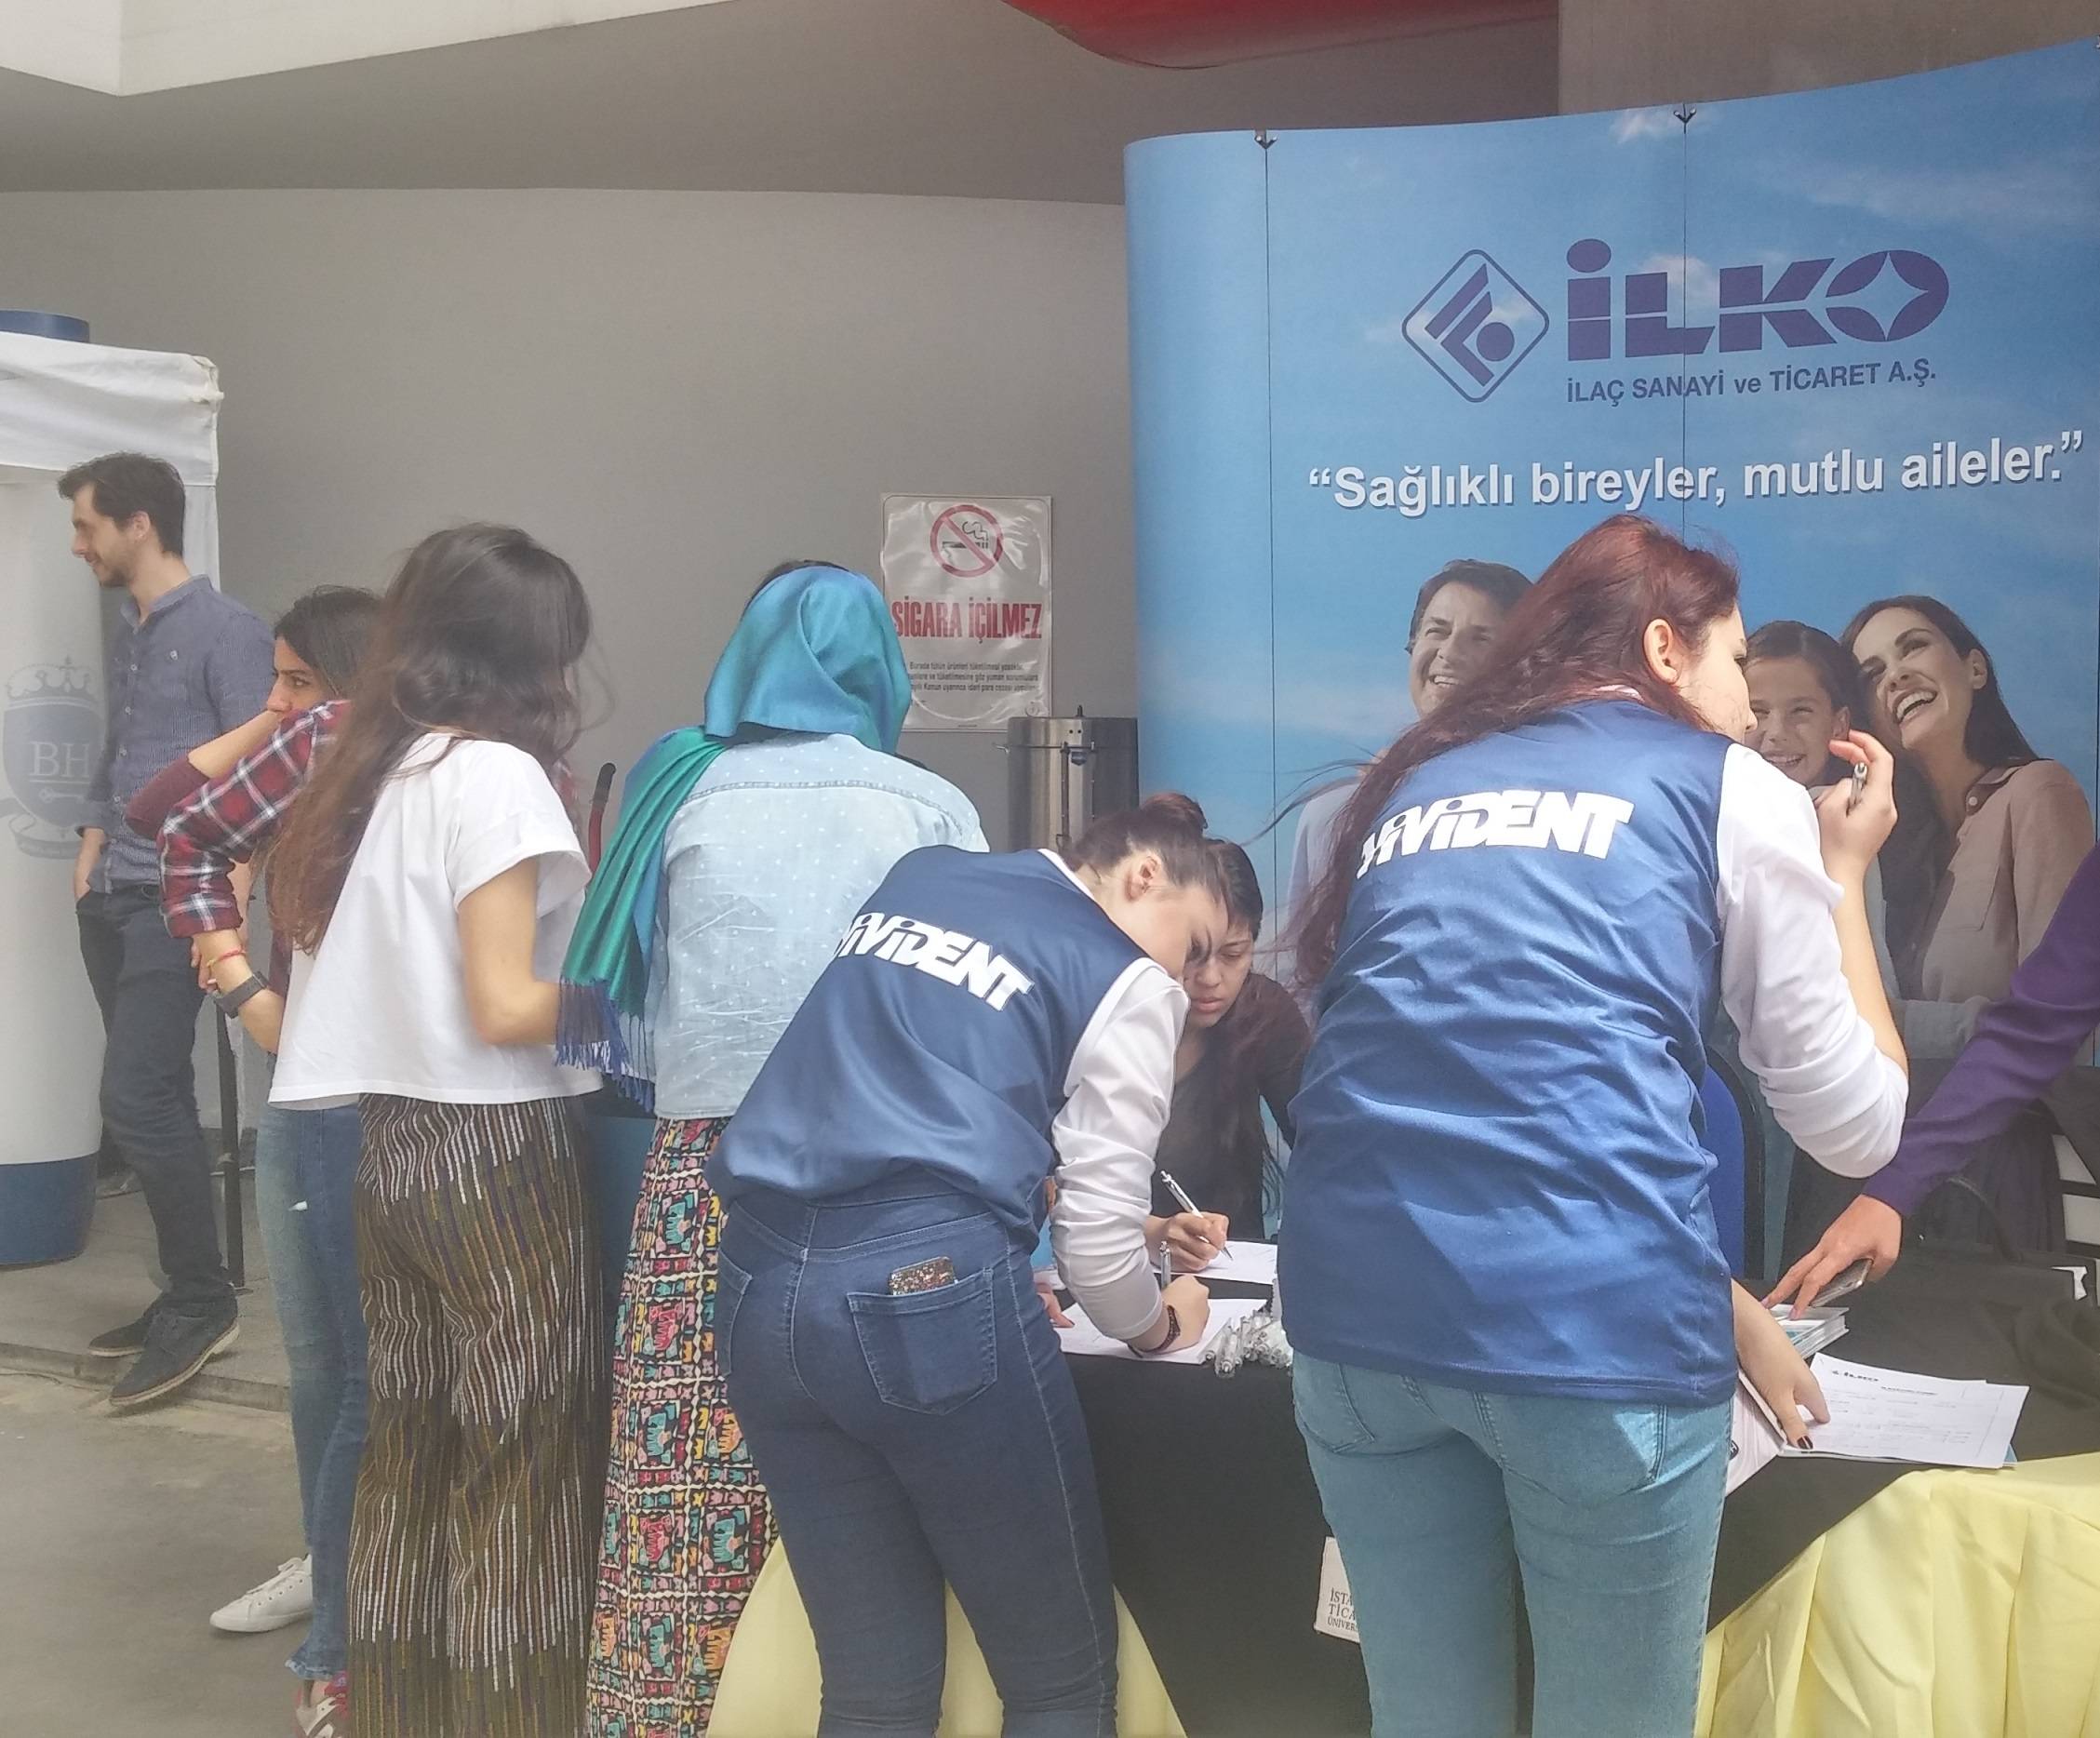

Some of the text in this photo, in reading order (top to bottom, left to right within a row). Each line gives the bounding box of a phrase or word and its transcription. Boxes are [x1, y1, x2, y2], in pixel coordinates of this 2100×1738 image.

[1567, 357, 1936, 408] İLAÇ SANAYİ ve TİCARET A.Ş.
[1532, 457, 1726, 512] bireyler,
[1744, 448, 1883, 497] mutlu
[891, 595, 1042, 643] SİGARA İÇİLMEZ
[29, 741, 90, 778] BH
